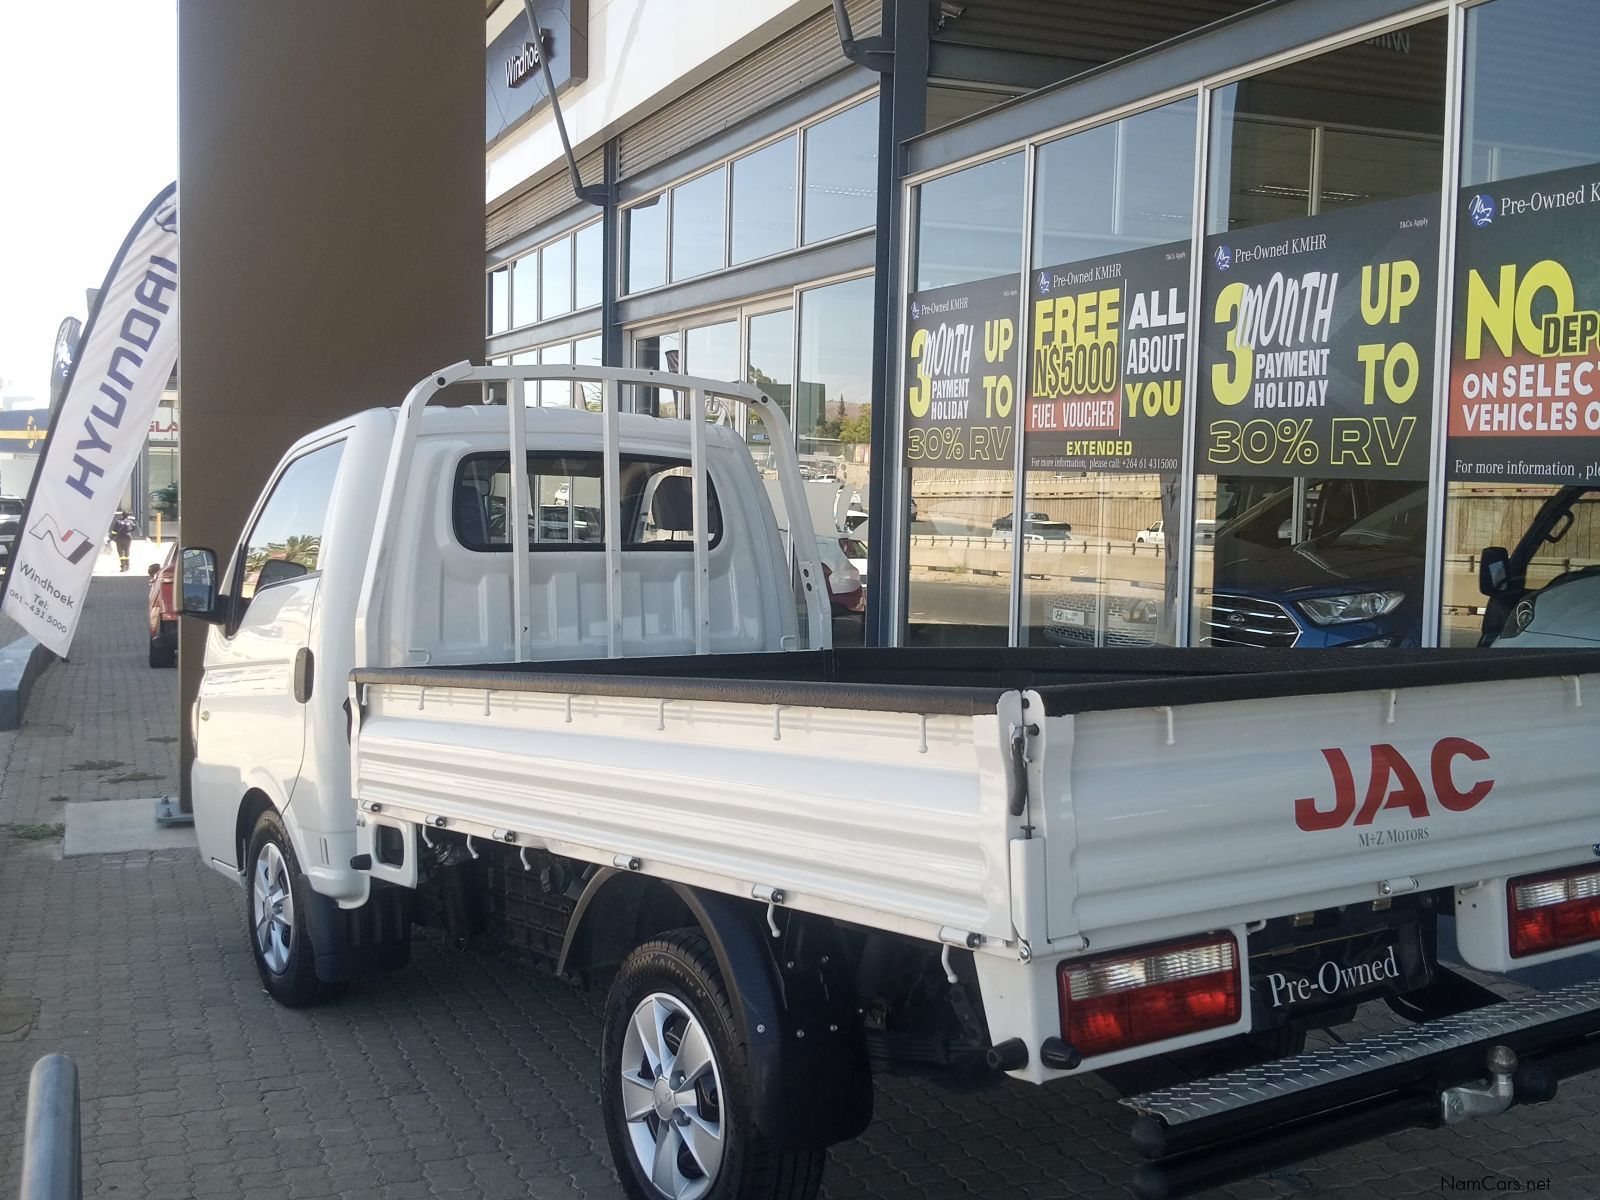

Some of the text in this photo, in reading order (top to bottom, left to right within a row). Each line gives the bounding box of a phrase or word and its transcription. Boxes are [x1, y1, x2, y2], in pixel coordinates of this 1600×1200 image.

[505, 28, 544, 88] Windhoe
[1500, 185, 1585, 216] Pre-Owned
[1234, 233, 1327, 263] Pre-Owned KMHR
[1053, 268, 1093, 288] Pre-Owned
[1095, 263, 1122, 281] KMHR
[1360, 260, 1420, 326] UP
[921, 299, 949, 316] Pre-Owned
[950, 297, 969, 312] KMHR
[1034, 288, 1120, 350] FREE
[1128, 288, 1187, 330] ALL
[1465, 260, 1575, 360] NO
[984, 318, 1014, 363] UP
[1211, 282, 1252, 406] 3
[1541, 310, 1600, 357] DEP
[910, 328, 932, 418] 3
[1032, 340, 1119, 399] N$5000
[1126, 333, 1185, 375] ABOUT
[1255, 349, 1330, 379] PAYMENT
[1357, 341, 1419, 405] TO
[65, 255, 177, 500] HYUNDAI
[932, 378, 970, 399] PAYMENT
[982, 374, 1013, 418] TO
[1253, 380, 1329, 408] HOLIDAY
[1462, 361, 1600, 399] ON SELEC
[931, 400, 969, 420] HOLIDAY
[1031, 400, 1115, 429] FUEL VOUCHER
[1125, 380, 1182, 418] YOU
[1462, 402, 1578, 432] VEHICLES
[907, 426, 1012, 461] 30% RV
[1066, 440, 1133, 456] EXTENDED
[1208, 416, 1417, 466] 30% RV
[1089, 458, 1108, 470] please
[1148, 458, 1178, 470] 4315000
[1455, 459, 1473, 474] For
[1475, 462, 1504, 475] more
[20, 560, 75, 609] Windhoek
[46, 614, 68, 634] 5000
[1294, 736, 1495, 832] JAC
[1358, 831, 1385, 848] M+Z
[1266, 945, 1400, 1008] Pre-Owned
